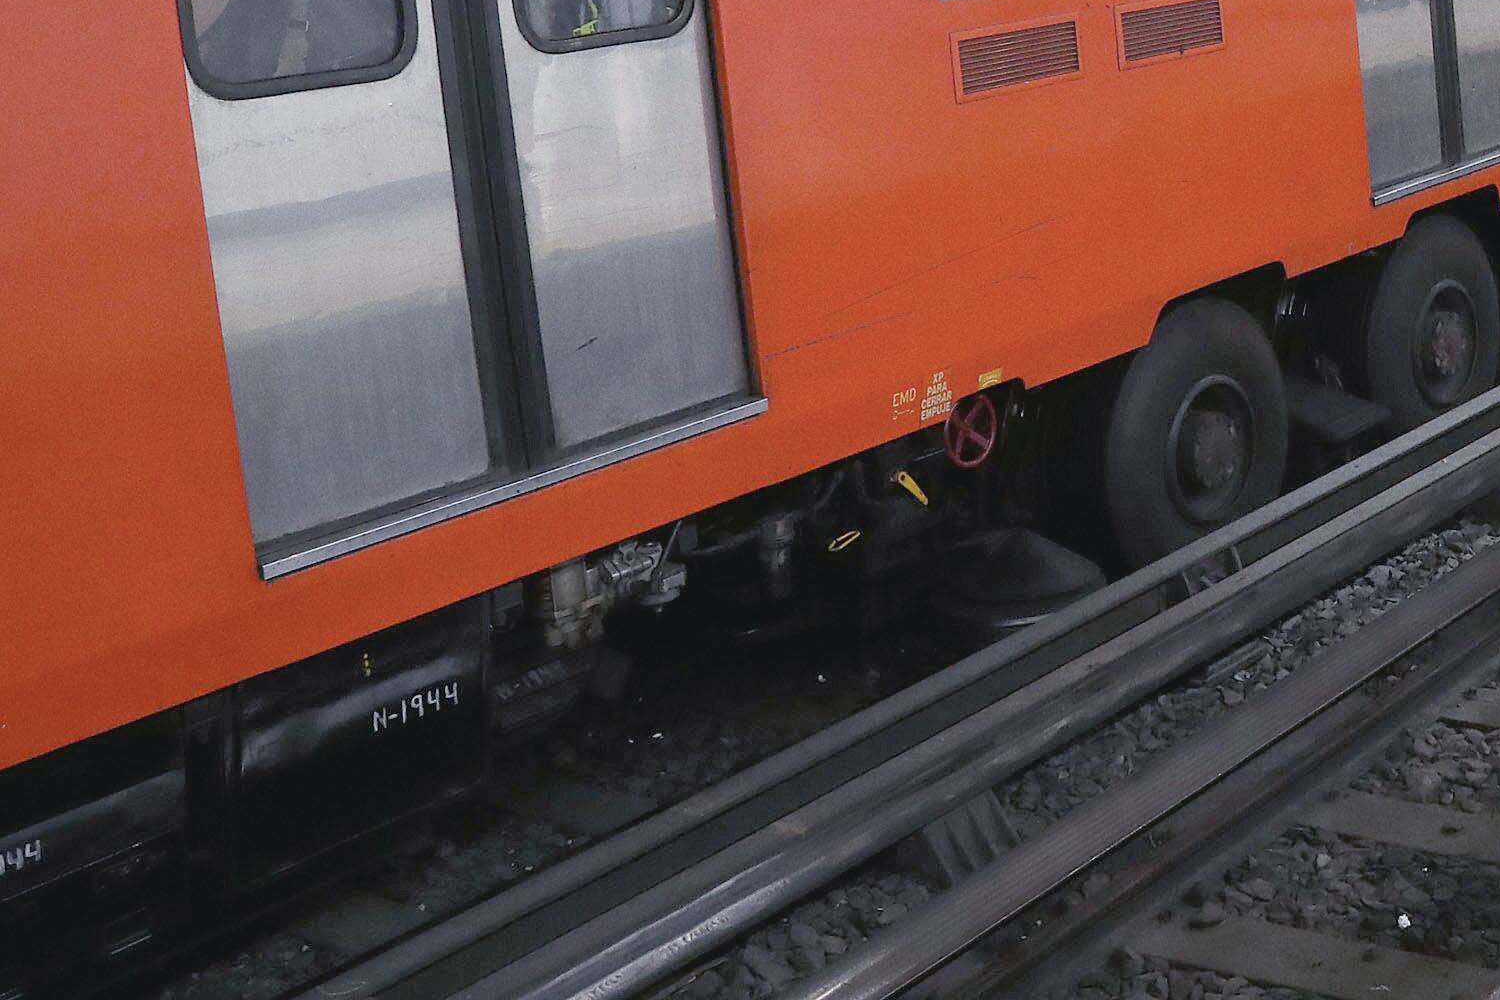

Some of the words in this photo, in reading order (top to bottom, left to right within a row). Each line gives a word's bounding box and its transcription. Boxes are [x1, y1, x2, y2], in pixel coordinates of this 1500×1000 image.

[926, 381, 948, 397] PARA
[921, 390, 953, 410] CERRAR
[921, 401, 952, 421] EMPUJE
[372, 681, 459, 733] N-1944
